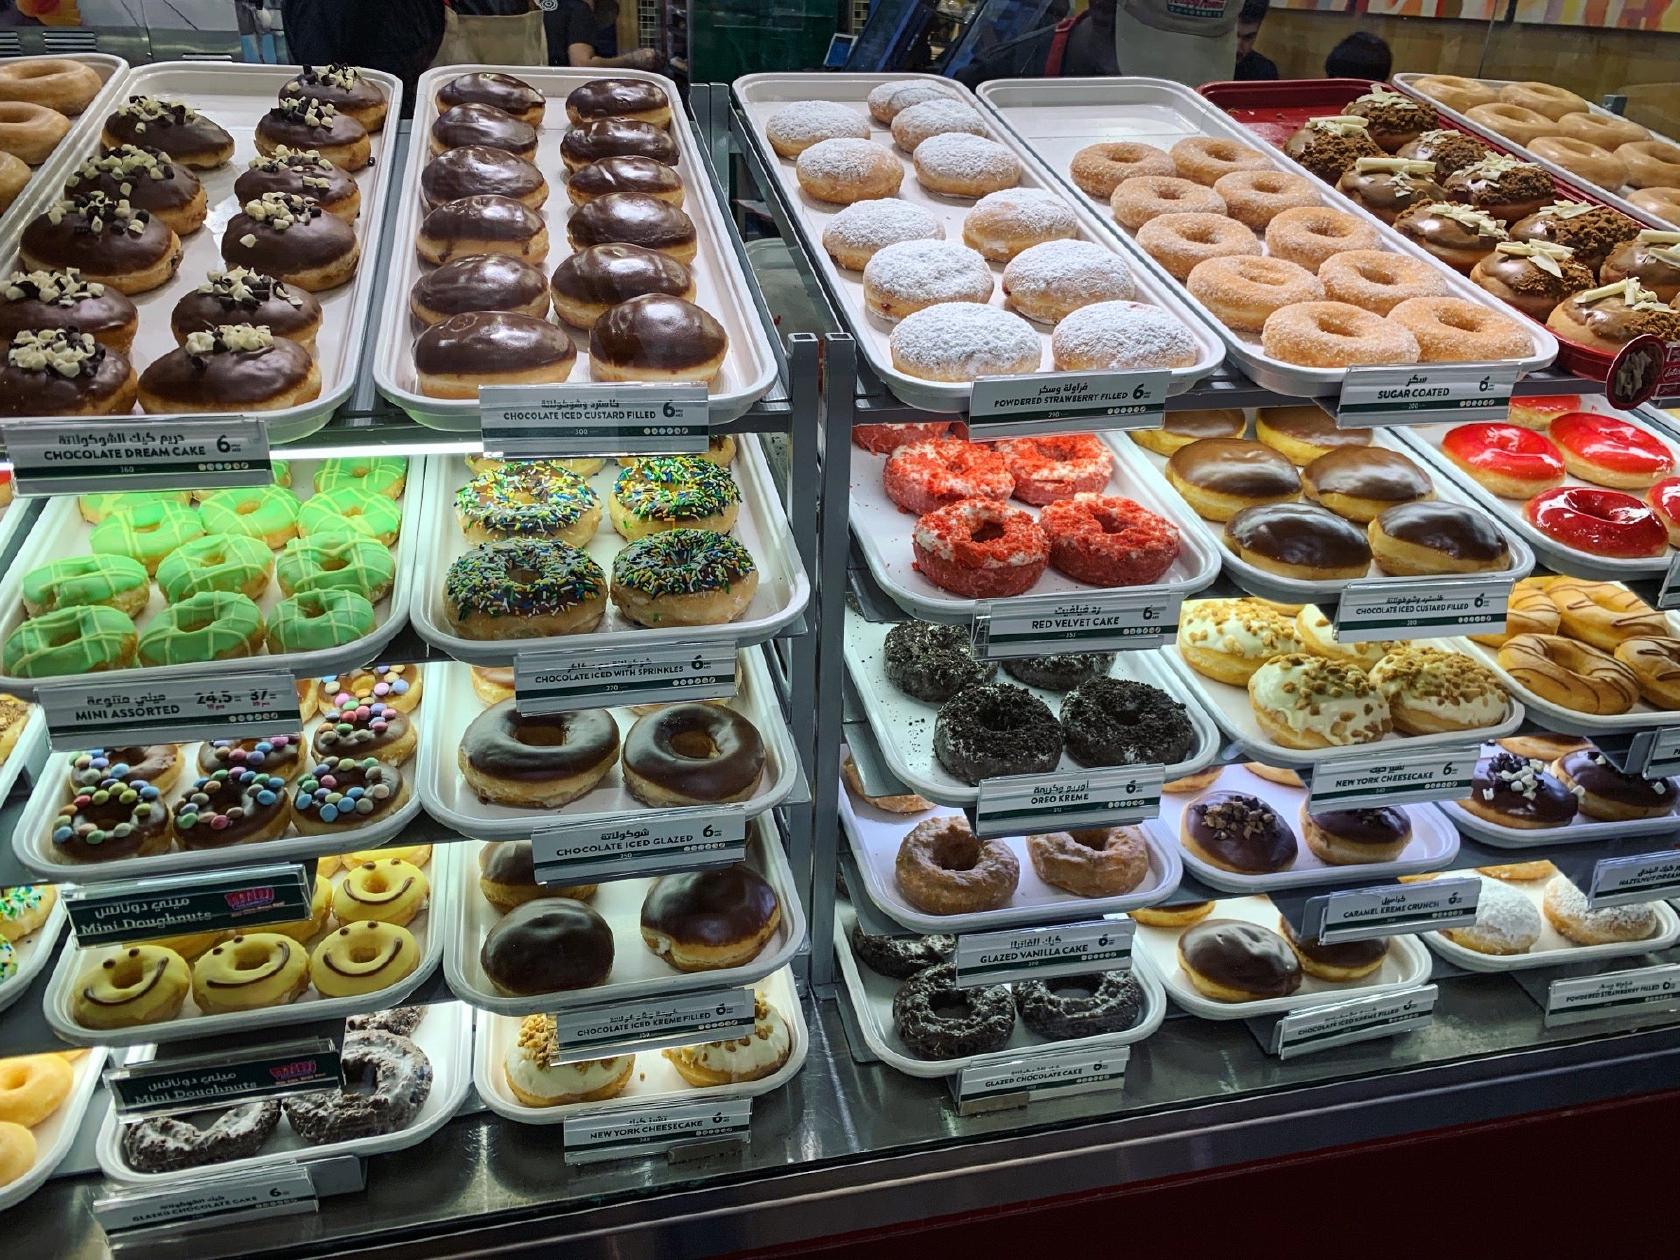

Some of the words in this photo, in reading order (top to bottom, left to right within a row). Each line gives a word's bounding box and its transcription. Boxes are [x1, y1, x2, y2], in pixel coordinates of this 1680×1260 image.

[1406, 375, 1428, 387] سكر
[1479, 376, 1490, 391] 6
[1038, 384, 1060, 395] وسكر
[1064, 383, 1088, 394] فراولة
[1133, 384, 1144, 399] 6
[1378, 389, 1410, 399] SUGAR
[1412, 388, 1449, 398] COATED
[994, 397, 1041, 407] POWDERED
[1044, 394, 1099, 404] STRAWBERRY
[504, 412, 559, 420] CHOCOLATE
[561, 412, 582, 420] ICED
[584, 411, 625, 419] CUSTARD
[627, 411, 656, 419] FILLED
[663, 401, 675, 417] 6
[216, 435, 231, 453] 6
[44, 449, 122, 461] CHOCOLATE
[125, 448, 171, 458] DREAM
[173, 446, 206, 456] CAKE
[1474, 593, 1484, 608] 6
[1143, 606, 1152, 620] 6
[1356, 605, 1397, 615] CHOCOLATE
[1399, 605, 1414, 613] ICED
[1416, 603, 1446, 612] CUSTARD
[1032, 620, 1052, 629] RED
[1055, 618, 1090, 628] VELVET
[1093, 616, 1119, 626] CAKE
[691, 655, 703, 670] 6
[535, 672, 590, 684] CHOCOLATE
[591, 671, 612, 679] ICED
[614, 669, 636, 677] WITH
[638, 666, 684, 676] SPRINKLES
[195, 692, 232, 705] 24.5
[249, 688, 268, 701] 37
[75, 711, 108, 721] MINI
[111, 705, 180, 718] ASSORTED
[1443, 762, 1452, 775] 6
[1126, 780, 1136, 794] 6
[1335, 778, 1356, 788] NEW
[1357, 776, 1378, 785] YORK
[1381, 772, 1434, 783] CHEESECAKE
[1030, 796, 1056, 805] OREO
[1059, 793, 1089, 802] KREME
[600, 828, 650, 841] شوكولاتة
[703, 824, 713, 838] 6
[556, 843, 622, 857] CHOCOLATE
[625, 840, 650, 849] ICED
[653, 835, 694, 845] GLAZED
[151, 896, 190, 913] ميني
[1448, 892, 1458, 904] 6
[95, 900, 148, 919] دوناتس
[1343, 909, 1378, 918] CARAMEL
[1381, 905, 1406, 913] KREME
[1407, 901, 1439, 911] CRUNCH
[80, 921, 119, 936] Mini
[122, 910, 212, 930] Doughnuts
[1099, 933, 1108, 947] 6
[980, 952, 1018, 964] GLAZED
[1020, 948, 1060, 958] VANILLA
[1062, 944, 1088, 954] CAKE
[1566, 992, 1600, 1002] POWDERED
[1600, 988, 1639, 997] STRAWBERRY
[716, 1003, 726, 1016] 6
[577, 1025, 629, 1037] CHOCOLATE
[631, 1021, 650, 1029] ICED
[653, 1016, 682, 1026] KREME
[683, 1012, 711, 1022] FILLED
[1298, 1021, 1337, 1035] CHOCOLATE
[1338, 1018, 1353, 1027] ICED
[1354, 1012, 1378, 1024] KREME
[1378, 1008, 1399, 1018] FILLED
[201, 1072, 237, 1085] ميني
[985, 1078, 1014, 1088] GLAZED
[1016, 1071, 1061, 1082] CHOCOLATE
[1062, 1068, 1083, 1076] CAKE
[135, 1093, 172, 1105] Mini
[174, 1081, 257, 1099] Doughnuts
[712, 1112, 723, 1123] 6
[590, 1131, 612, 1140] NEW
[614, 1127, 640, 1137] YORK
[642, 1120, 703, 1133] CHEESECAKE
[269, 1187, 282, 1198] 6
[132, 1210, 171, 1223] GLAZED
[171, 1201, 231, 1216] CHOCOLATE
[232, 1196, 258, 1205] CAKE
